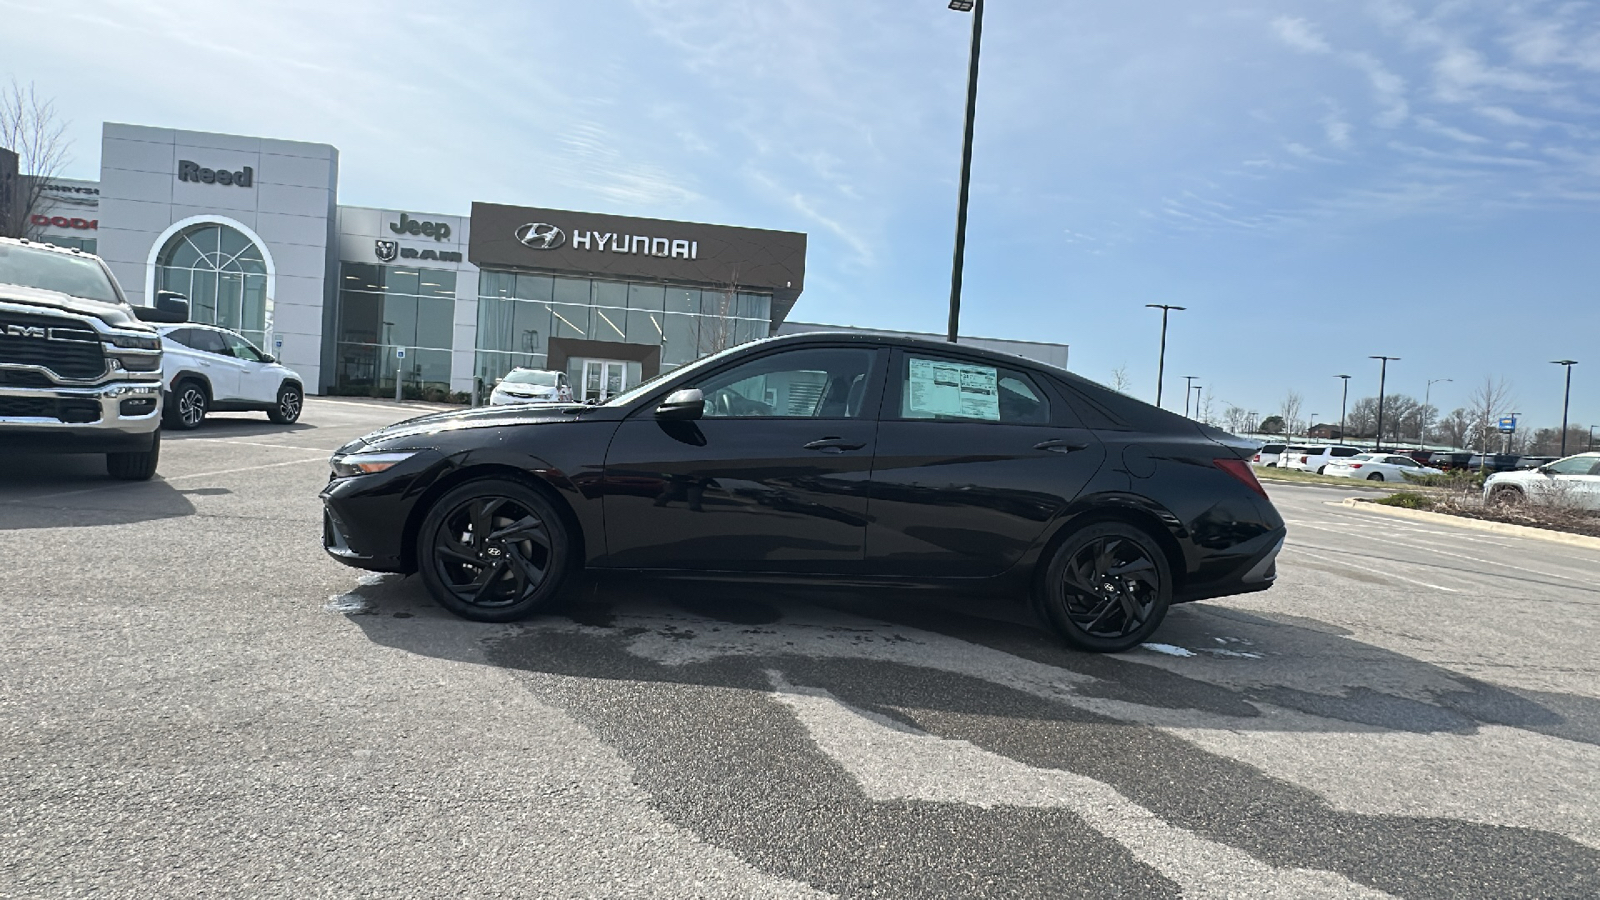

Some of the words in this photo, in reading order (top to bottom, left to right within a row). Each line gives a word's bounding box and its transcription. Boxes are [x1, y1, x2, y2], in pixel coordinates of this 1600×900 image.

[178, 159, 253, 188] Reed
[390, 213, 451, 241] Jeep
[400, 247, 463, 262] RAM
[572, 229, 698, 260] HYUNDAI
